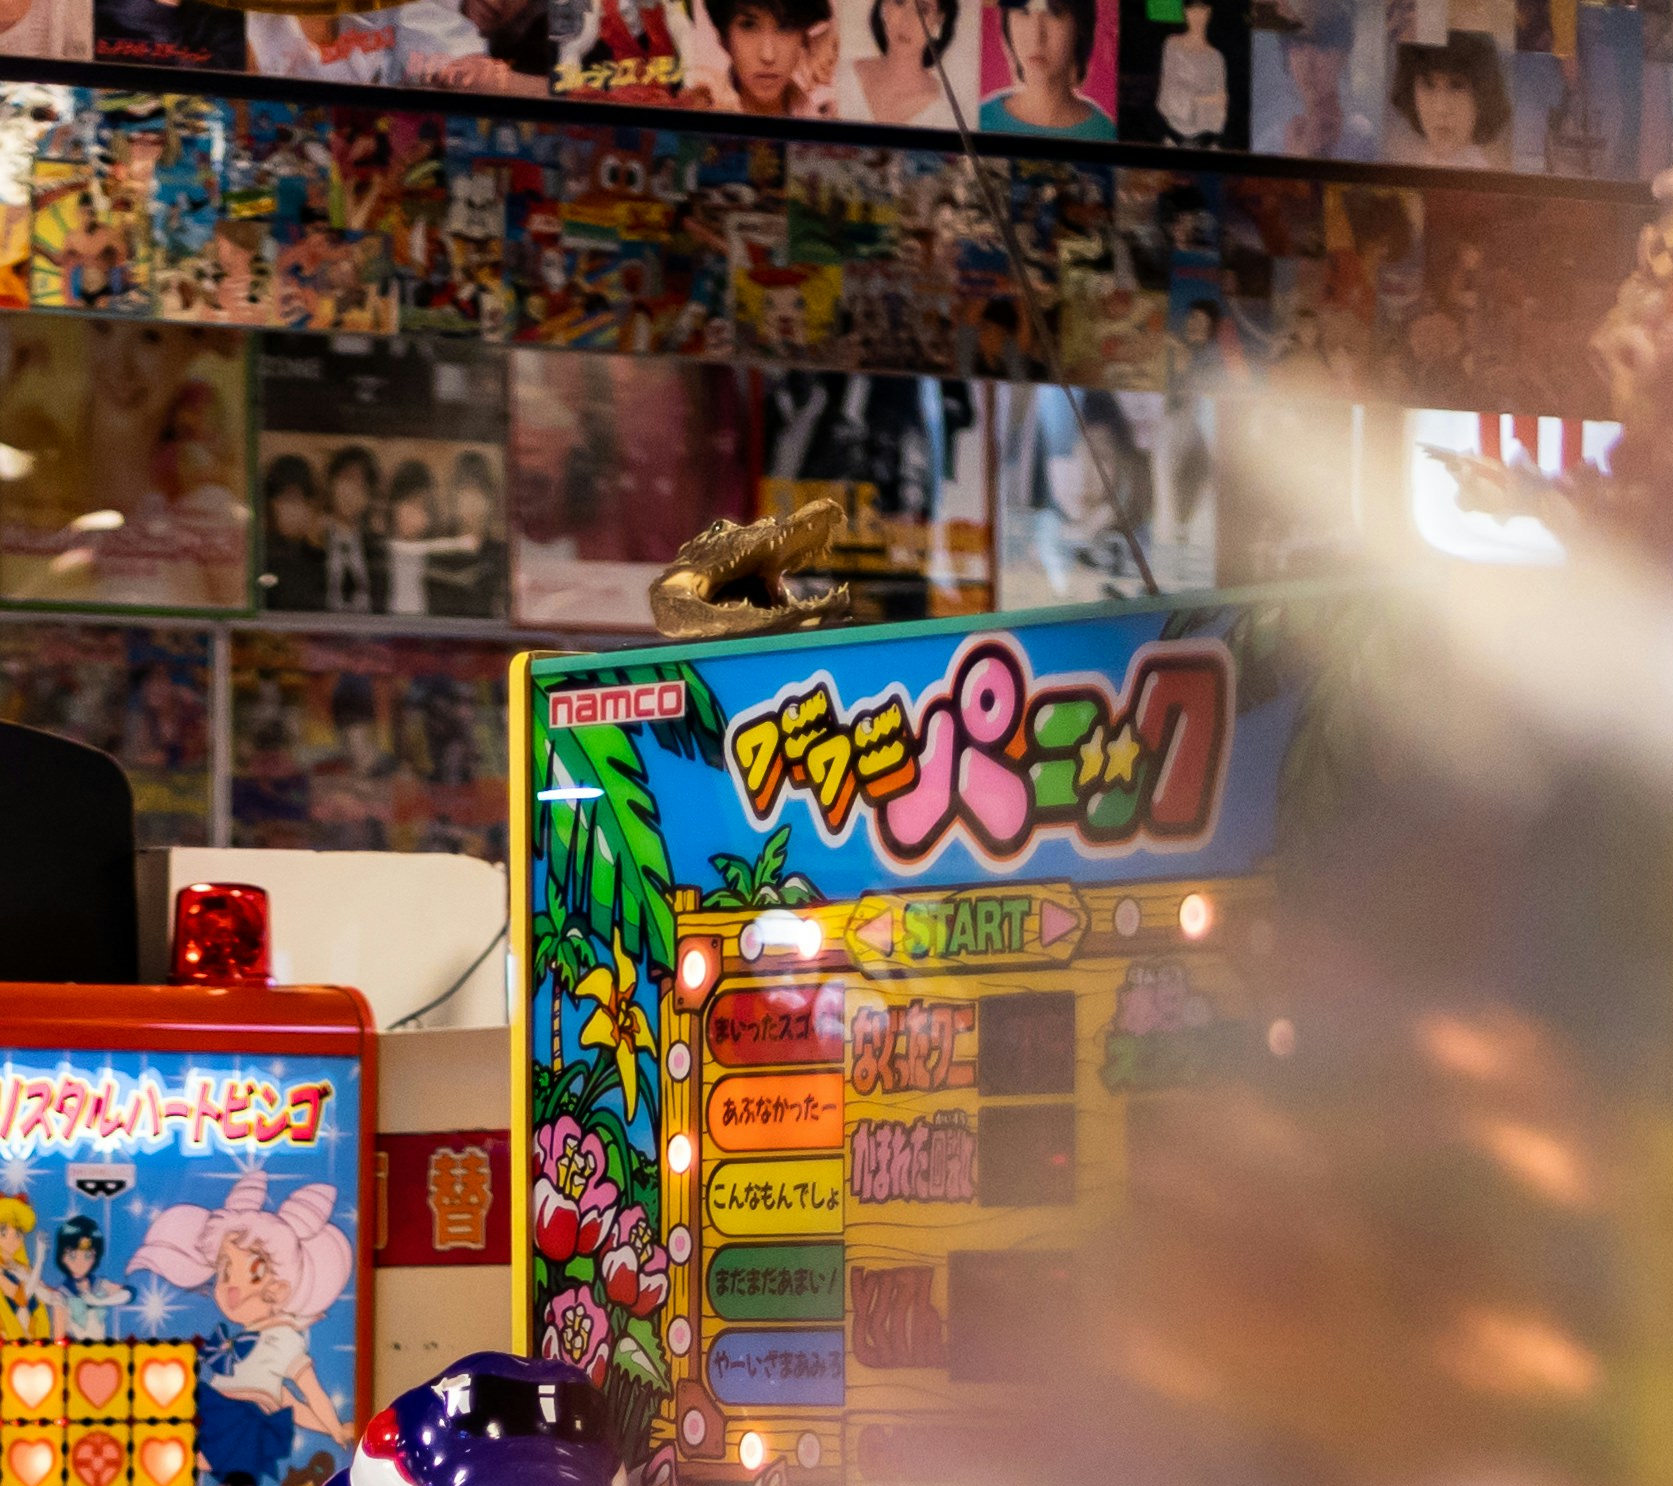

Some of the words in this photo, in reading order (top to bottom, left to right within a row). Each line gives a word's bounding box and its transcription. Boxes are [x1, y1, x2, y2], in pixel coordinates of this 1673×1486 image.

[549, 683, 684, 726] namco
[901, 899, 1032, 957] START
[712, 1181, 840, 1211] こんなもんでしょ
